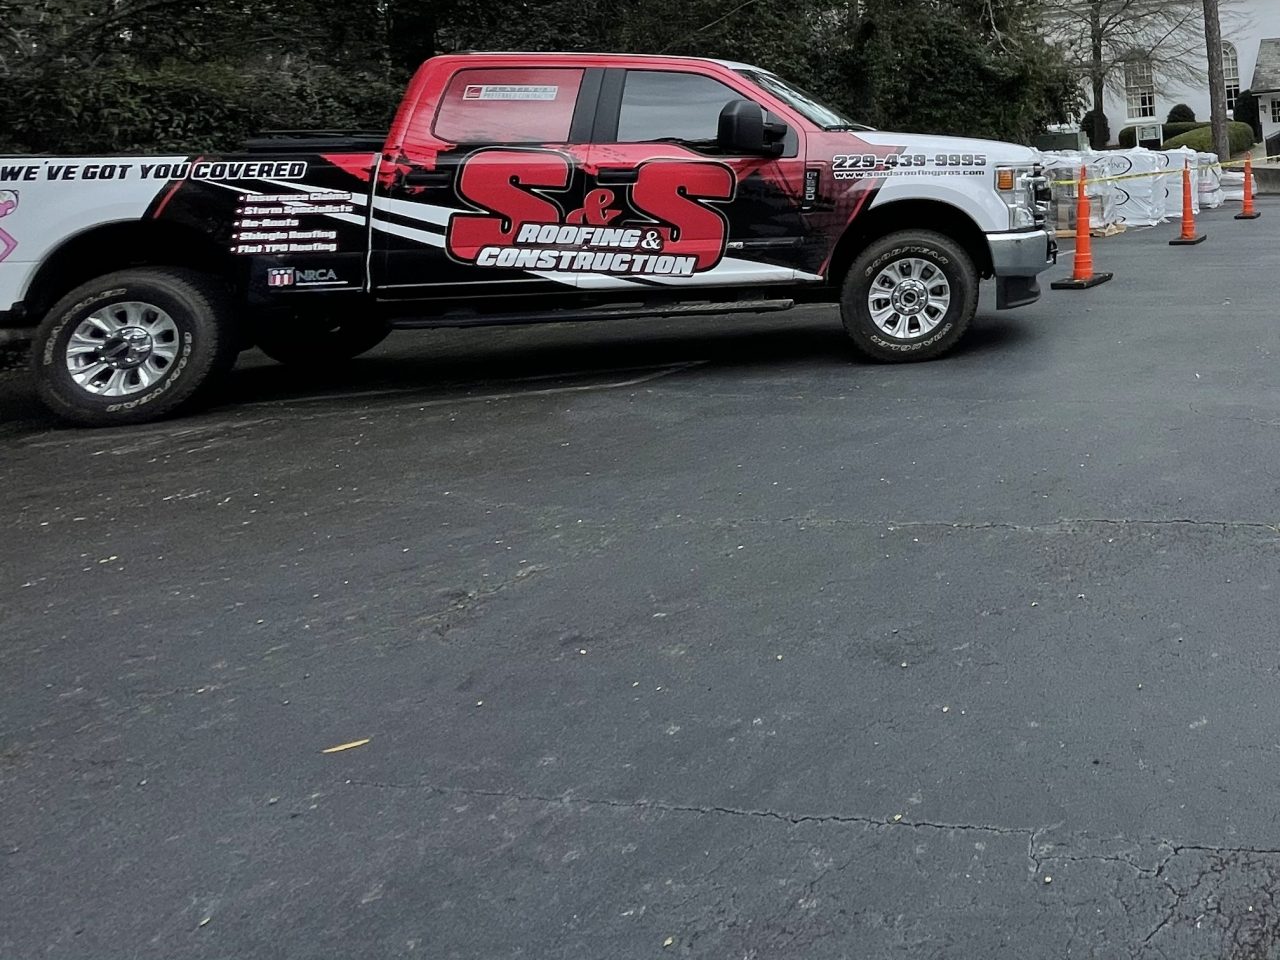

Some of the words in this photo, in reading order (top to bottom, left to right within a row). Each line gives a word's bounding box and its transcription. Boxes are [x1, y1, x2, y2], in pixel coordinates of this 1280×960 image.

[833, 154, 987, 170] 229-439-9995
[0, 161, 79, 181] WE'VE
[81, 164, 132, 180] GOT
[140, 162, 189, 179] YOU
[191, 161, 307, 180] COVERED
[246, 194, 309, 202] Insurance
[310, 192, 351, 201] Claims
[244, 206, 283, 215] Storm
[283, 205, 353, 215] Specialists
[239, 231, 288, 241] Shingle
[288, 231, 336, 239] Roofing
[516, 224, 642, 248] ROOFING
[237, 244, 263, 253] Flat
[289, 243, 337, 252] Roofing
[476, 247, 697, 275] CONSTRUCTION
[865, 246, 949, 277] GOODYEAR
[295, 268, 338, 282] NRCA
[106, 331, 193, 413] GOODYEAR
